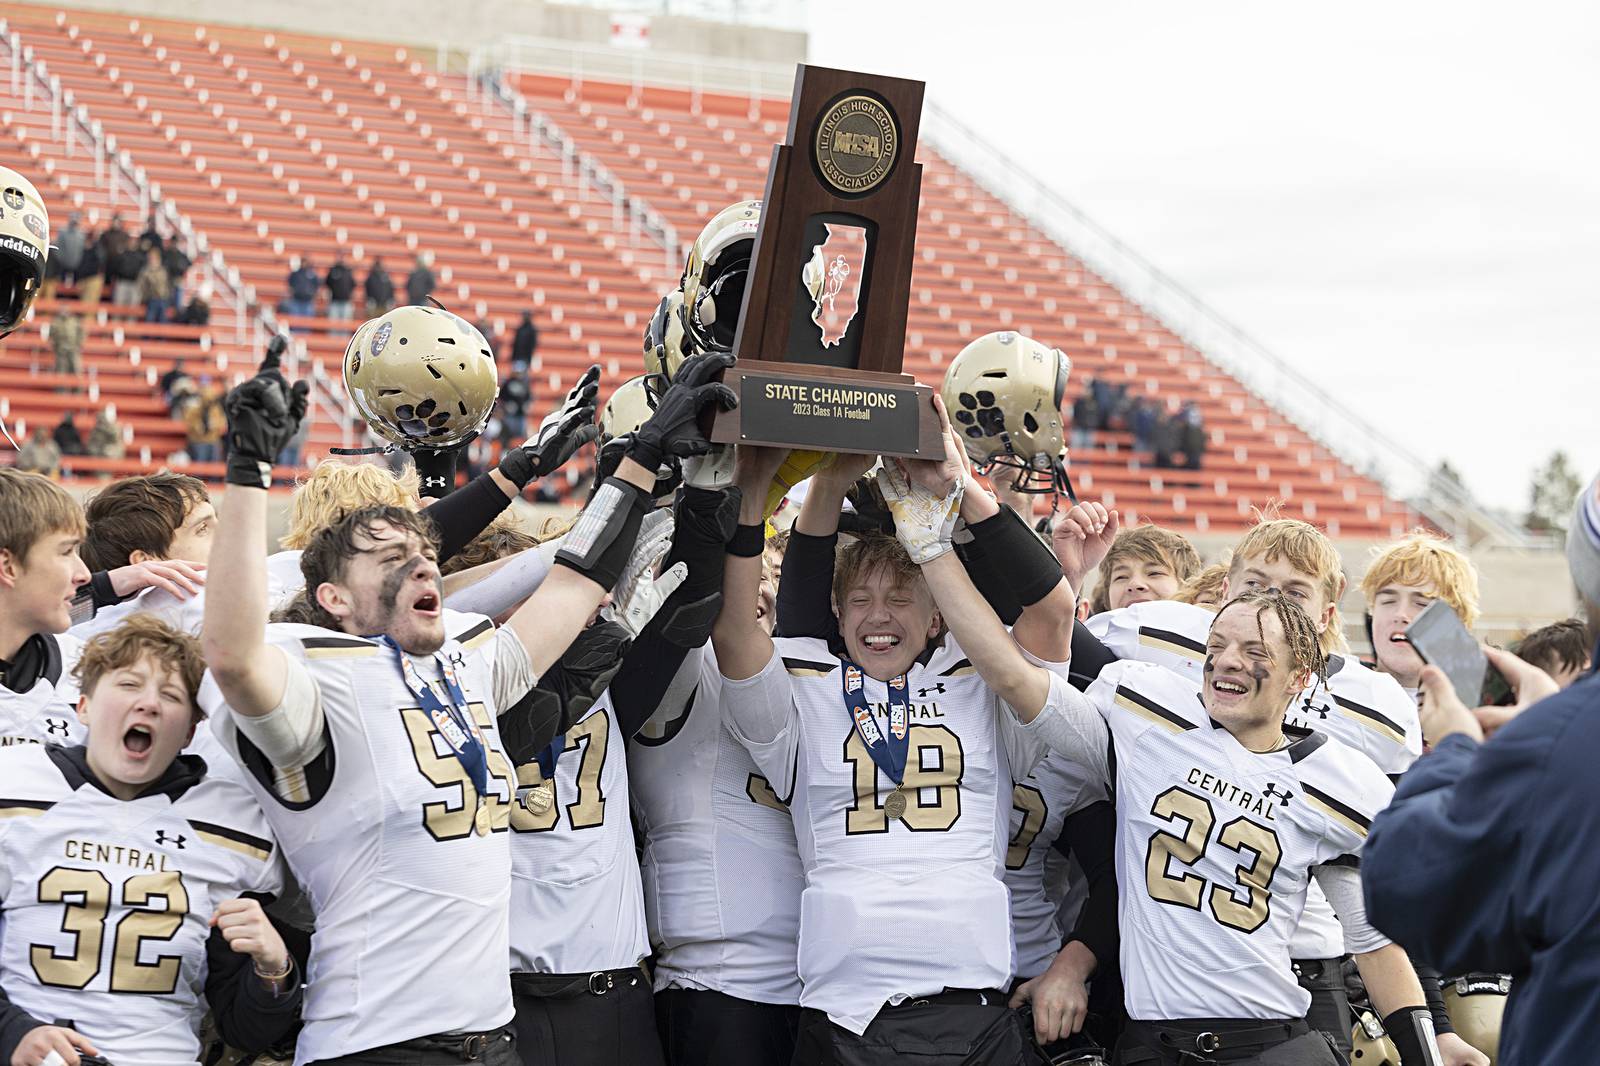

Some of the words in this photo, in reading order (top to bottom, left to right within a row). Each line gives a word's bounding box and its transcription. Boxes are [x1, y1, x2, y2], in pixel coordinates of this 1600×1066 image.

[821, 105, 848, 149] ILLINOIS
[851, 101, 876, 114] HIGH
[876, 111, 893, 158] SCHOOL
[822, 160, 884, 187] ASSOCIATION
[765, 384, 807, 402] STATE
[811, 387, 897, 409] CHAMPIONS
[792, 403, 811, 416] 2023
[812, 404, 831, 417] Class
[833, 406, 843, 418] 1A
[844, 407, 870, 421] Football
[843, 723, 964, 836] 18
[1187, 767, 1276, 821] CENTRAL
[65, 839, 170, 873] CENTRAL
[1144, 785, 1283, 935] 23
[29, 865, 190, 995] 32
